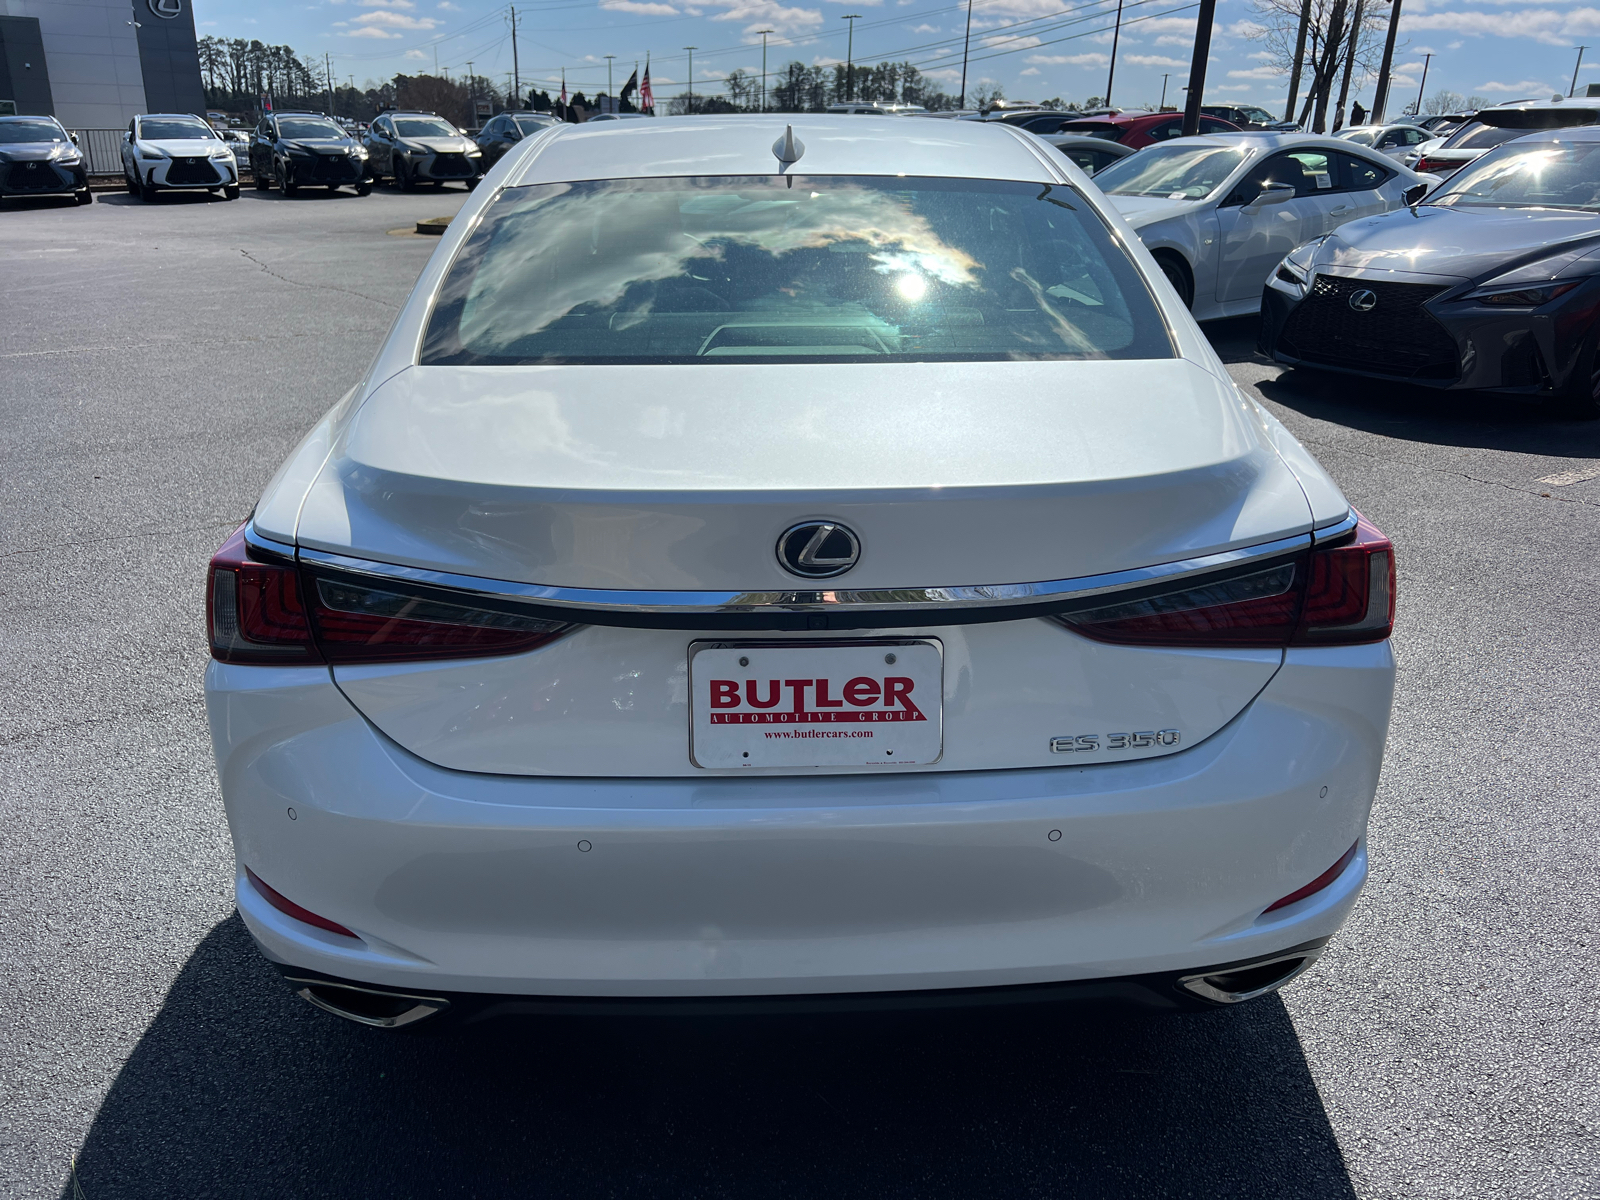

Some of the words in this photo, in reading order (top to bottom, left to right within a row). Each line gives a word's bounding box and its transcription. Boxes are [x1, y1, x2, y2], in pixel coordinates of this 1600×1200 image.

[711, 713, 837, 723] AUTOMOTIVE
[859, 711, 920, 721] GROUP
[764, 729, 874, 739] www.butlercars.com
[1050, 734, 1100, 754] ES
[1106, 728, 1181, 750] 350
